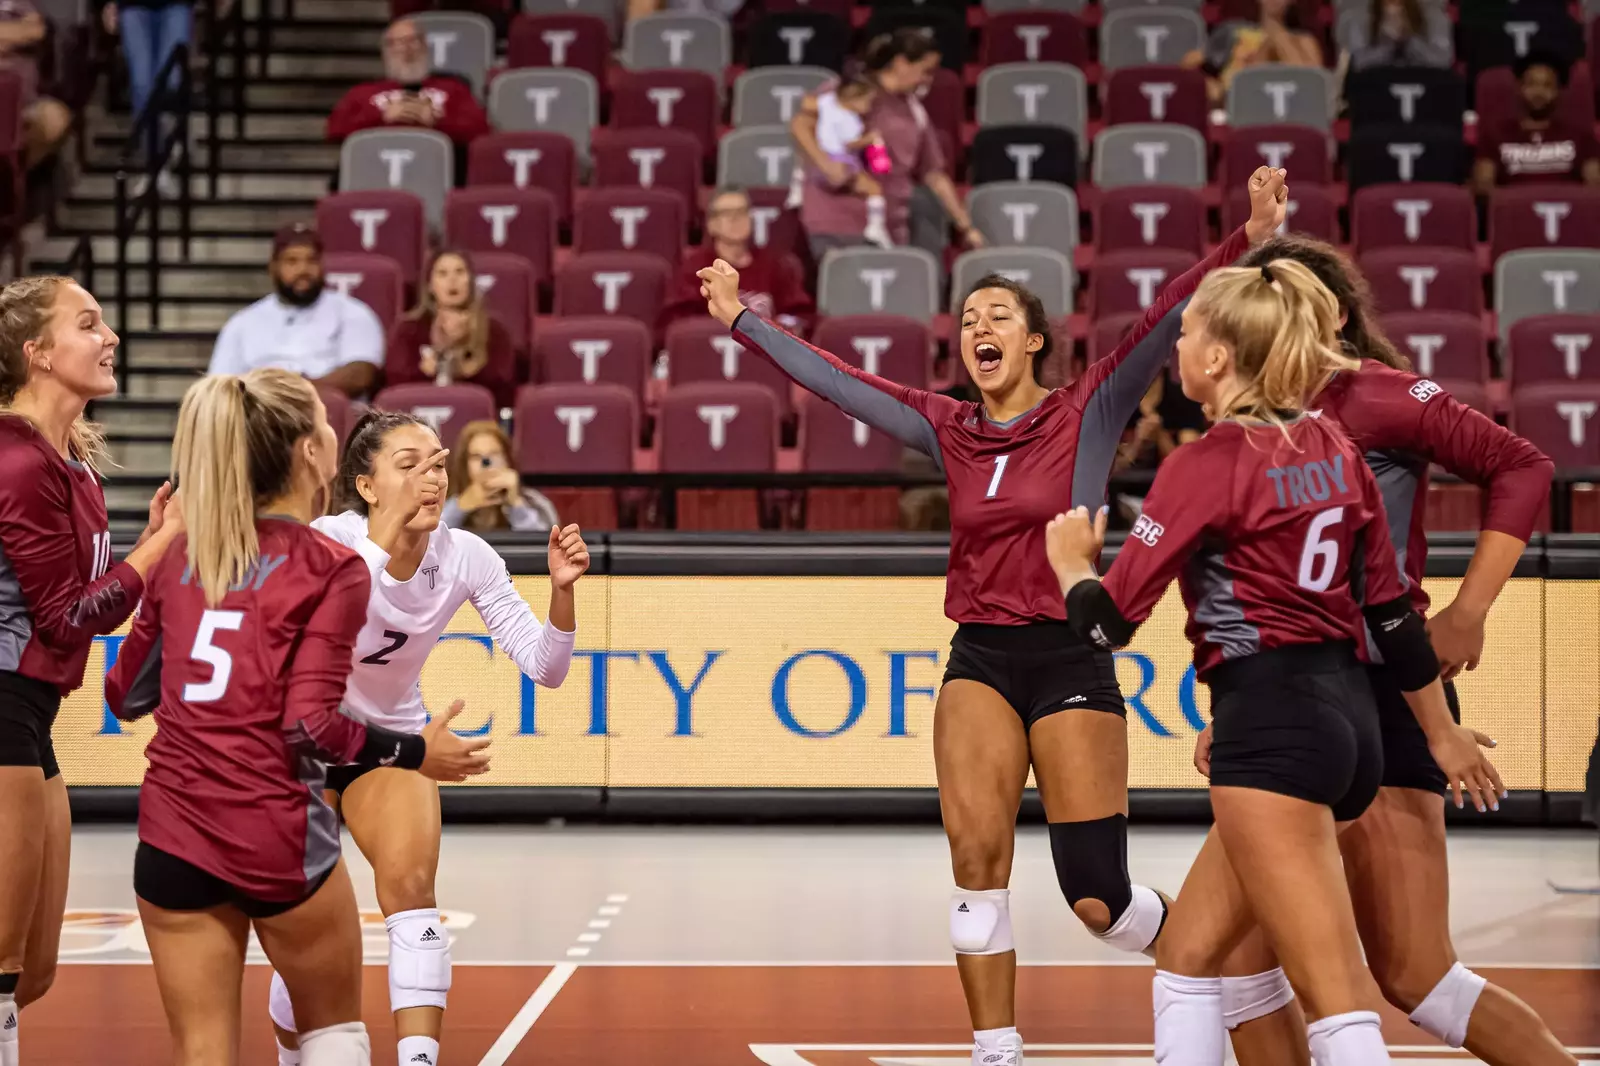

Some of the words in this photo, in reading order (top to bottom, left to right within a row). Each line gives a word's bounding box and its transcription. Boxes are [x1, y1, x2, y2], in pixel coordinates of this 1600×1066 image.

[428, 33, 456, 66] T
[541, 31, 575, 66] T
[663, 31, 692, 64] T
[780, 28, 813, 63] T
[1016, 27, 1050, 61] T
[1138, 27, 1168, 60] T
[1505, 22, 1537, 55] T
[527, 88, 558, 123] T
[649, 89, 681, 124] T
[772, 87, 803, 121] T
[1015, 85, 1047, 119] T
[1141, 83, 1174, 118] T
[1265, 83, 1296, 117] T
[1391, 84, 1424, 120] T
[380, 150, 413, 186] T
[506, 150, 539, 187] T
[630, 149, 664, 186] T
[758, 147, 791, 183] T
[1006, 145, 1043, 182] T
[1134, 143, 1167, 179] T
[1389, 144, 1423, 180] T
[352, 210, 387, 248] T
[482, 206, 517, 244] T
[612, 208, 647, 246] T
[750, 208, 778, 245] T
[1003, 204, 1037, 241] T
[1133, 204, 1167, 241] T
[1395, 200, 1430, 238] T
[1534, 203, 1569, 241] T
[595, 272, 630, 311] T
[860, 270, 895, 308] T
[1128, 269, 1164, 308] T
[1401, 267, 1436, 306] T
[1543, 271, 1577, 309] T
[572, 341, 609, 382] T
[712, 336, 744, 377] T
[853, 338, 890, 376] T
[1408, 336, 1443, 375] T
[1554, 335, 1590, 375] T
[556, 407, 595, 449] T
[699, 406, 737, 448] T
[1557, 402, 1596, 444] T
[986, 454, 1010, 498] 1
[1265, 454, 1350, 508] TROY
[90, 530, 111, 582] 10
[1298, 506, 1344, 593] 6
[421, 565, 440, 590] T
[183, 610, 243, 703] 5
[359, 629, 408, 665] 2
[771, 649, 940, 738] OF
